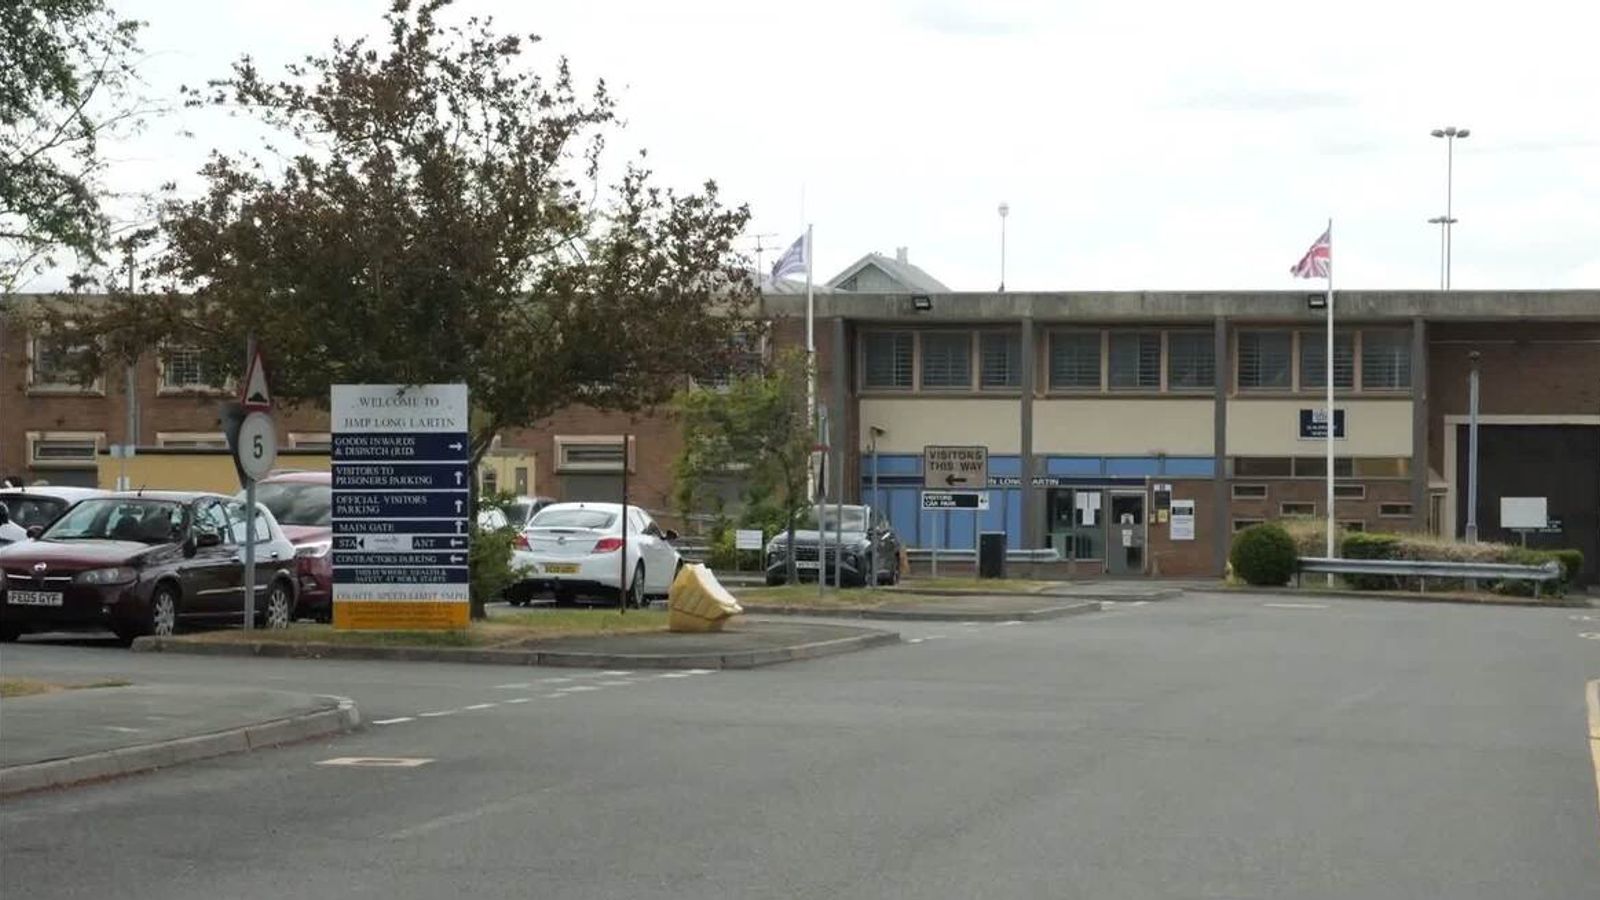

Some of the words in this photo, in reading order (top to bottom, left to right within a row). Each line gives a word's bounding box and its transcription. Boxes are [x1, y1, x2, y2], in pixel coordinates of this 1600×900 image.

[360, 397, 418, 408] WELCOME
[425, 397, 440, 408] TO
[344, 418, 371, 429] HMP
[374, 418, 406, 429] LONG
[409, 418, 455, 428] LARTIN
[335, 438, 368, 446] GOODS
[369, 438, 415, 446] INWARDS
[253, 435, 263, 459] 5
[335, 447, 342, 456] &
[345, 447, 389, 456] DISPATCH
[931, 451, 982, 460] VISITORS
[336, 466, 380, 475] VISITORS
[382, 466, 394, 475] TO
[930, 462, 954, 471] THIS
[960, 462, 982, 471] WAY
[336, 477, 388, 485] PRISONERS
[389, 476, 433, 485] PARKING
[1032, 479, 1059, 487] ARTIN
[336, 496, 380, 505] OFFICIAL
[383, 496, 428, 505] VISITORS
[337, 505, 381, 514] PARKING
[339, 523, 367, 532] MAIN
[368, 523, 394, 532] GATE
[336, 555, 398, 564] CONTRACTORS
[399, 555, 437, 563] PARKING
